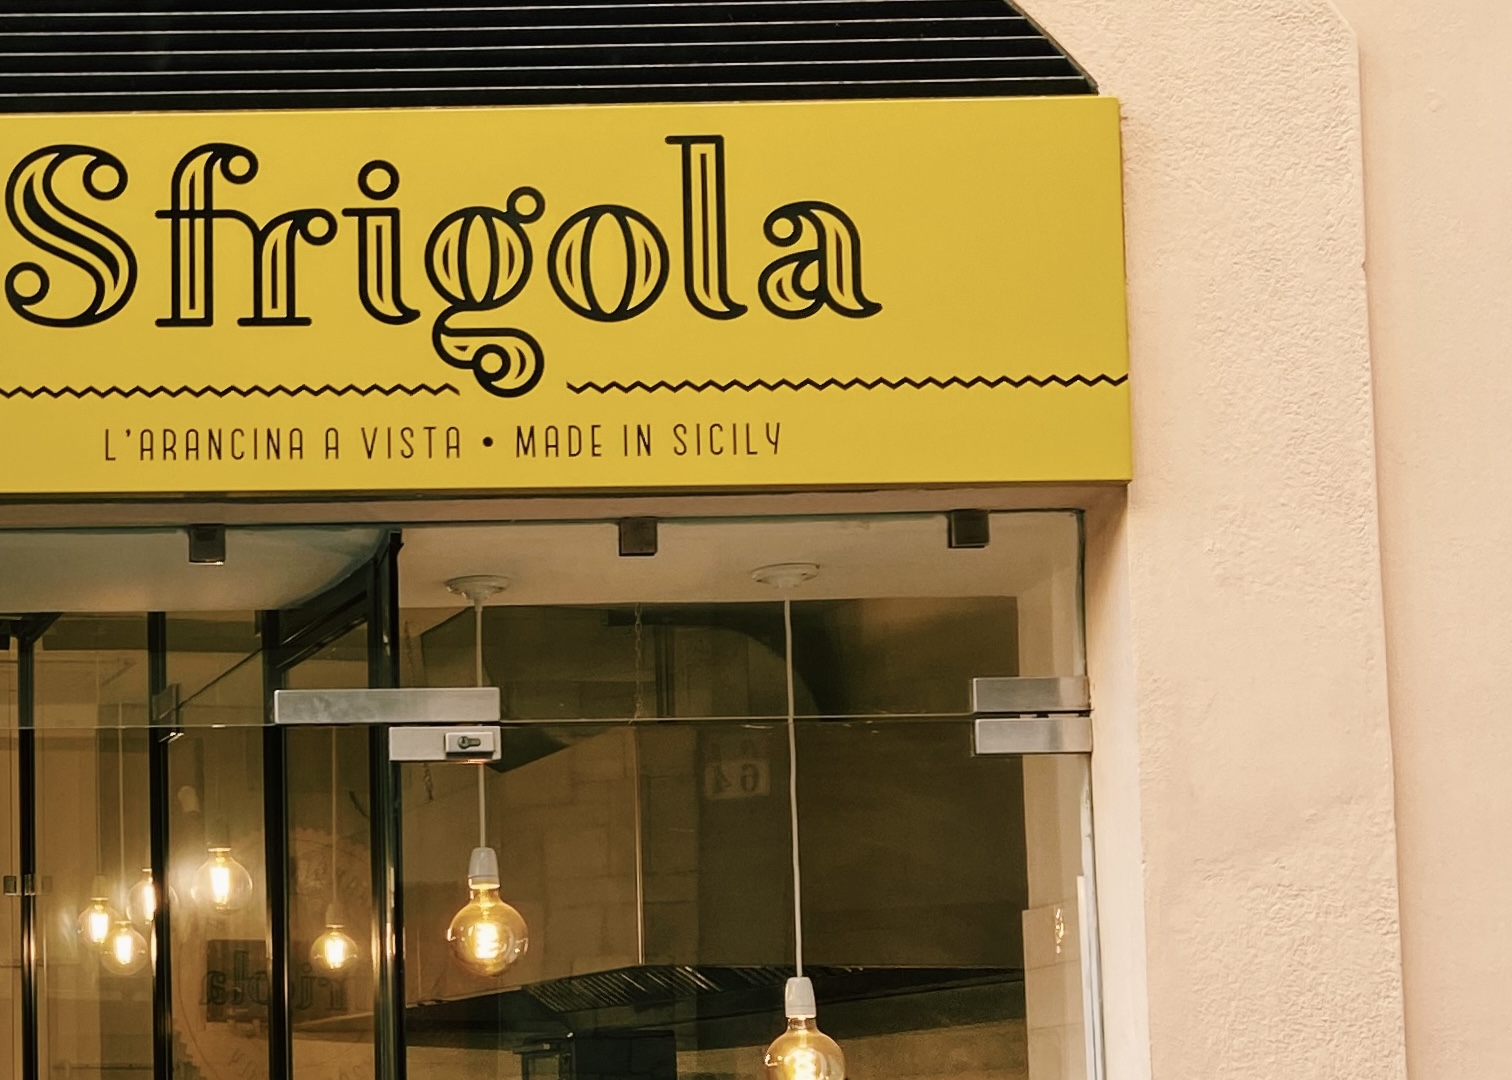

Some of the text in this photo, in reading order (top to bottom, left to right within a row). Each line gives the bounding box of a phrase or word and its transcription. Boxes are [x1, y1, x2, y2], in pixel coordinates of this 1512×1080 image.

[2, 135, 885, 398] Sfrigola
[105, 422, 780, 460] L'ARANCINA A VISTA MADE IN SICILY
